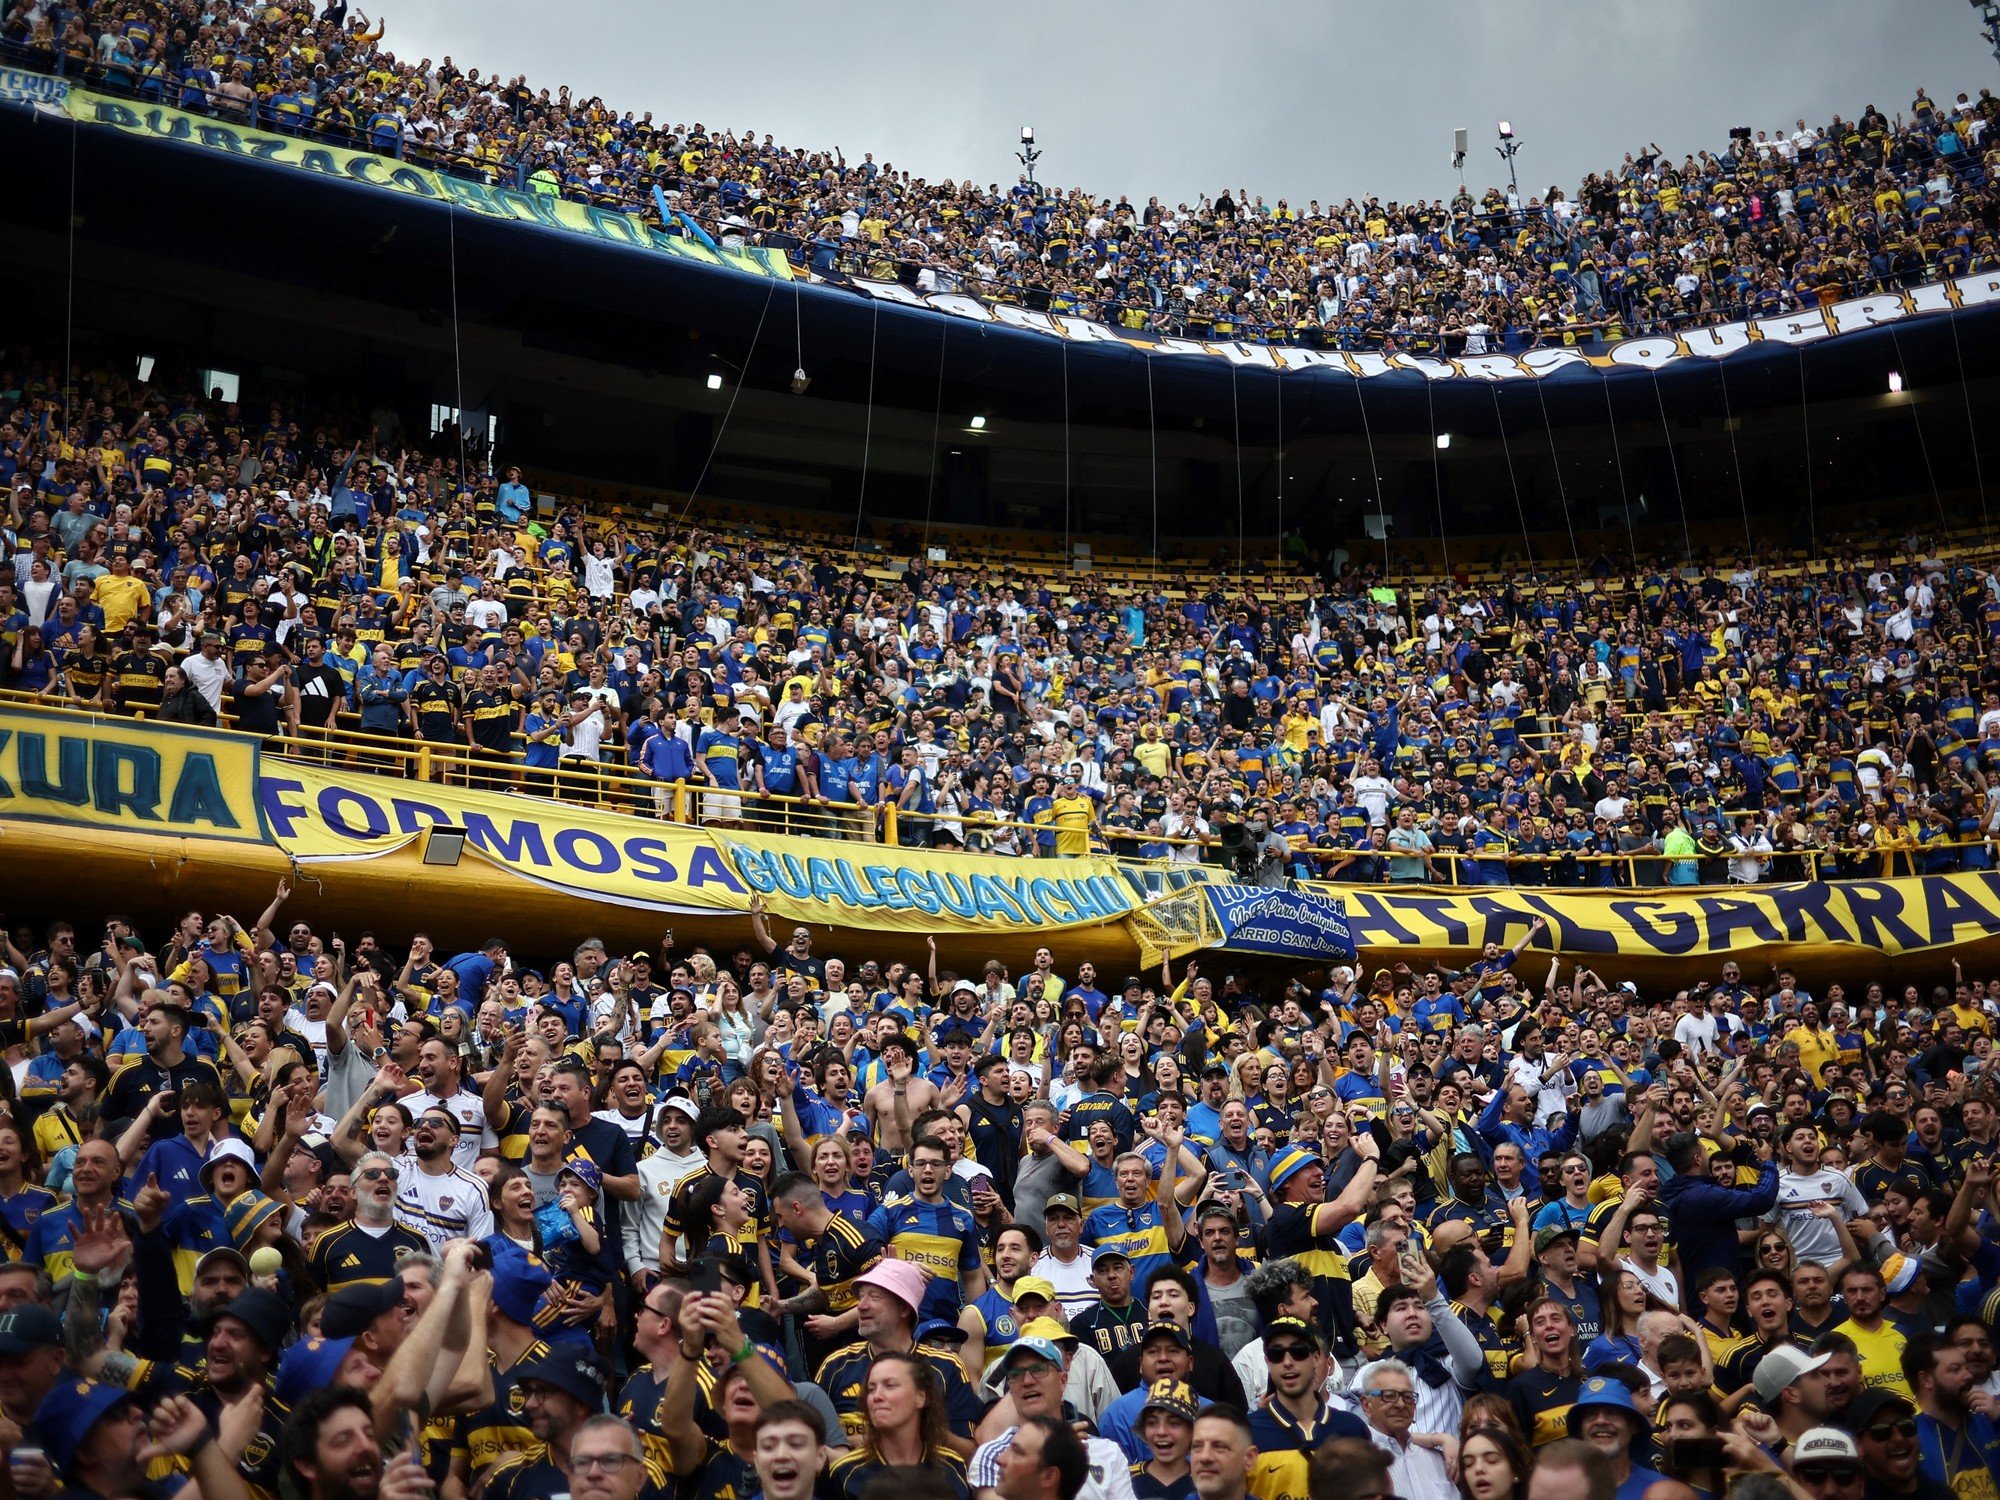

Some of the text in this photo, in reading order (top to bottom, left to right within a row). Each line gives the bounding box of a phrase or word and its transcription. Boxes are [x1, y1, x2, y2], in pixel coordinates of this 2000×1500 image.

[95, 102, 436, 197] BURZACO
[125, 676, 154, 684] betsson
[732, 847, 1132, 925] GUALEGUAYCHU
[1264, 896, 1297, 921] Para
[1296, 903, 1350, 938] Cualquiera
[1611, 872, 2000, 956] GARRA
[1231, 926, 1281, 943] ARRIO
[1280, 930, 1312, 948] SAN
[904, 1249, 957, 1268] betsso
[1095, 1321, 1144, 1355] BOC
